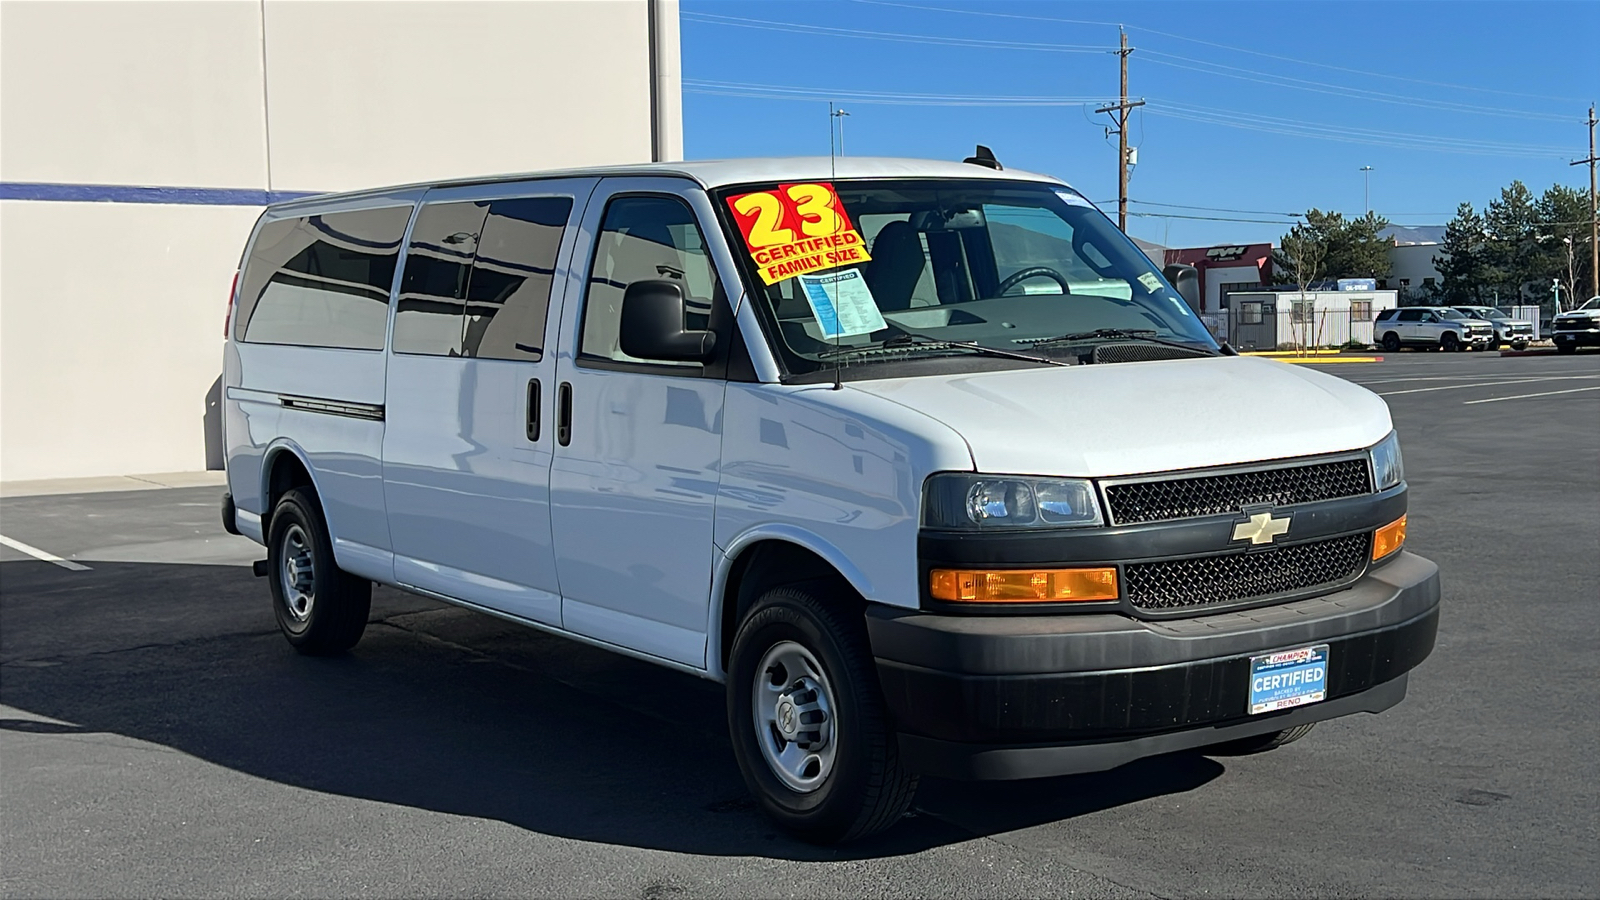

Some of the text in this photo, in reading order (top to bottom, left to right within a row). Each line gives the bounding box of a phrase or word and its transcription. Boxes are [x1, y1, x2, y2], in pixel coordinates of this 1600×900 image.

[734, 184, 844, 248] 23
[755, 232, 859, 265] CERTIFIED
[767, 248, 860, 280] FAMILY SIZE
[819, 273, 856, 284] CERTIFIED
[1272, 650, 1309, 663] CHAMPION
[1253, 667, 1324, 692] CERTIFIED
[1276, 697, 1301, 708] RENO
